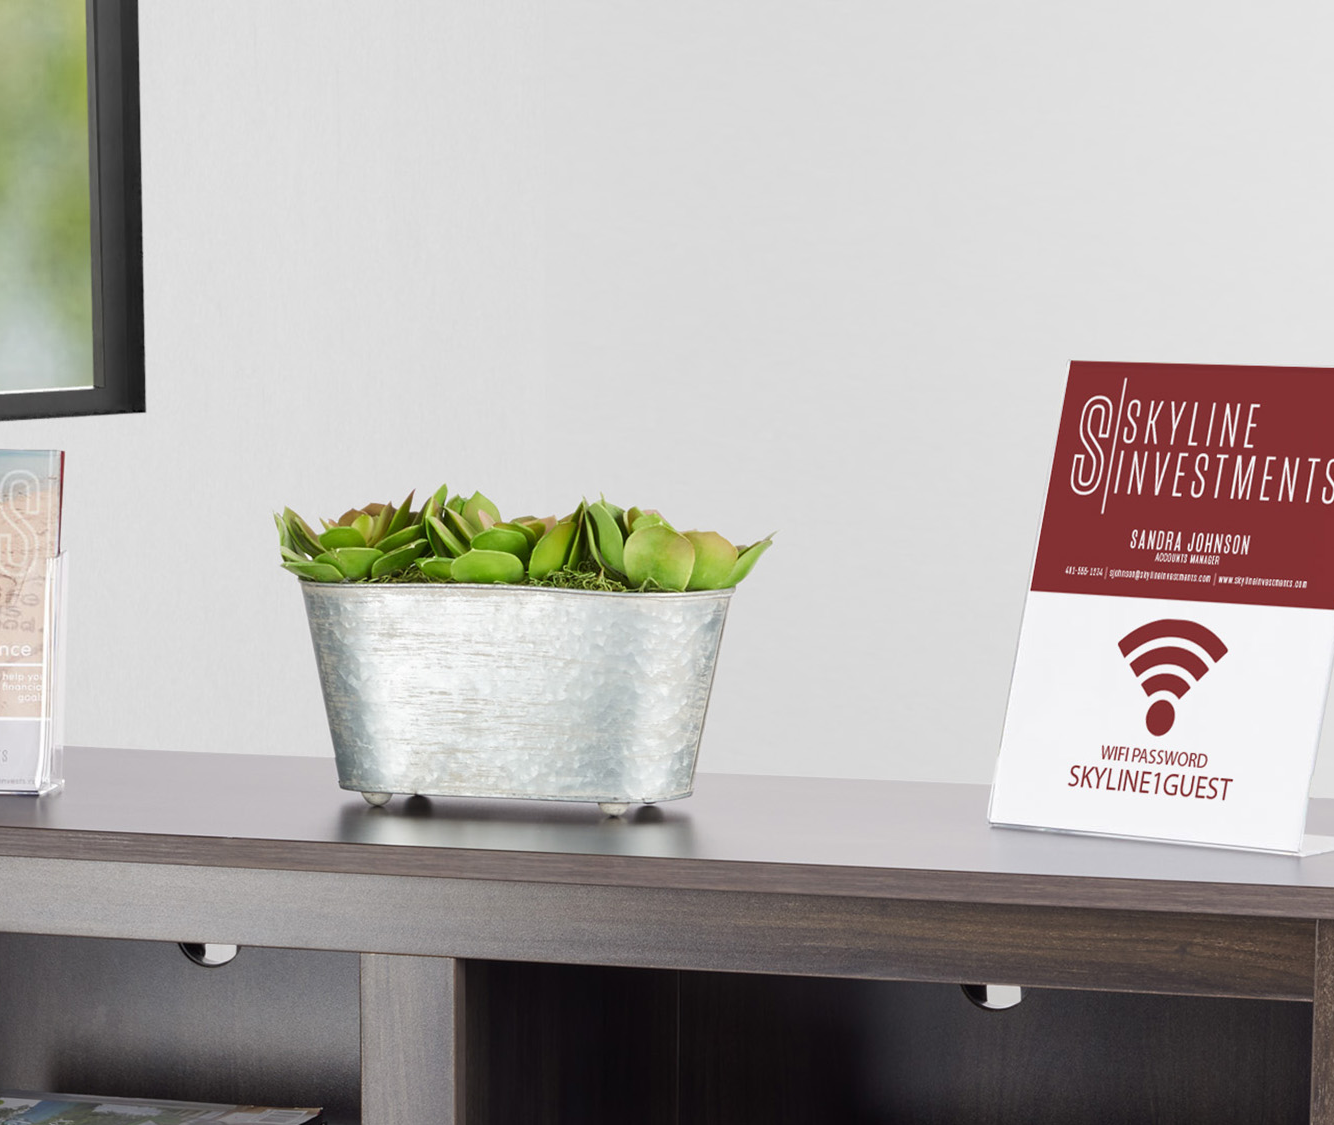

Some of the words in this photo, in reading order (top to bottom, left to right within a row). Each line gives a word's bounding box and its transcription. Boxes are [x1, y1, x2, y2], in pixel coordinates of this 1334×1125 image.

[1123, 399, 1261, 448] SKYLINE
[1129, 529, 1182, 552] SANDRA
[1187, 532, 1251, 556] JOHNSON
[1154, 552, 1188, 564] ACCOUNTS
[1189, 554, 1220, 565] MANAGER
[2, 671, 25, 682] help
[2, 681, 43, 691] financia
[17, 693, 42, 704] goal
[1101, 745, 1130, 762] WIFI
[1131, 747, 1208, 768] PASSWORD
[1067, 764, 1234, 801] SKYLINE1GUEST
